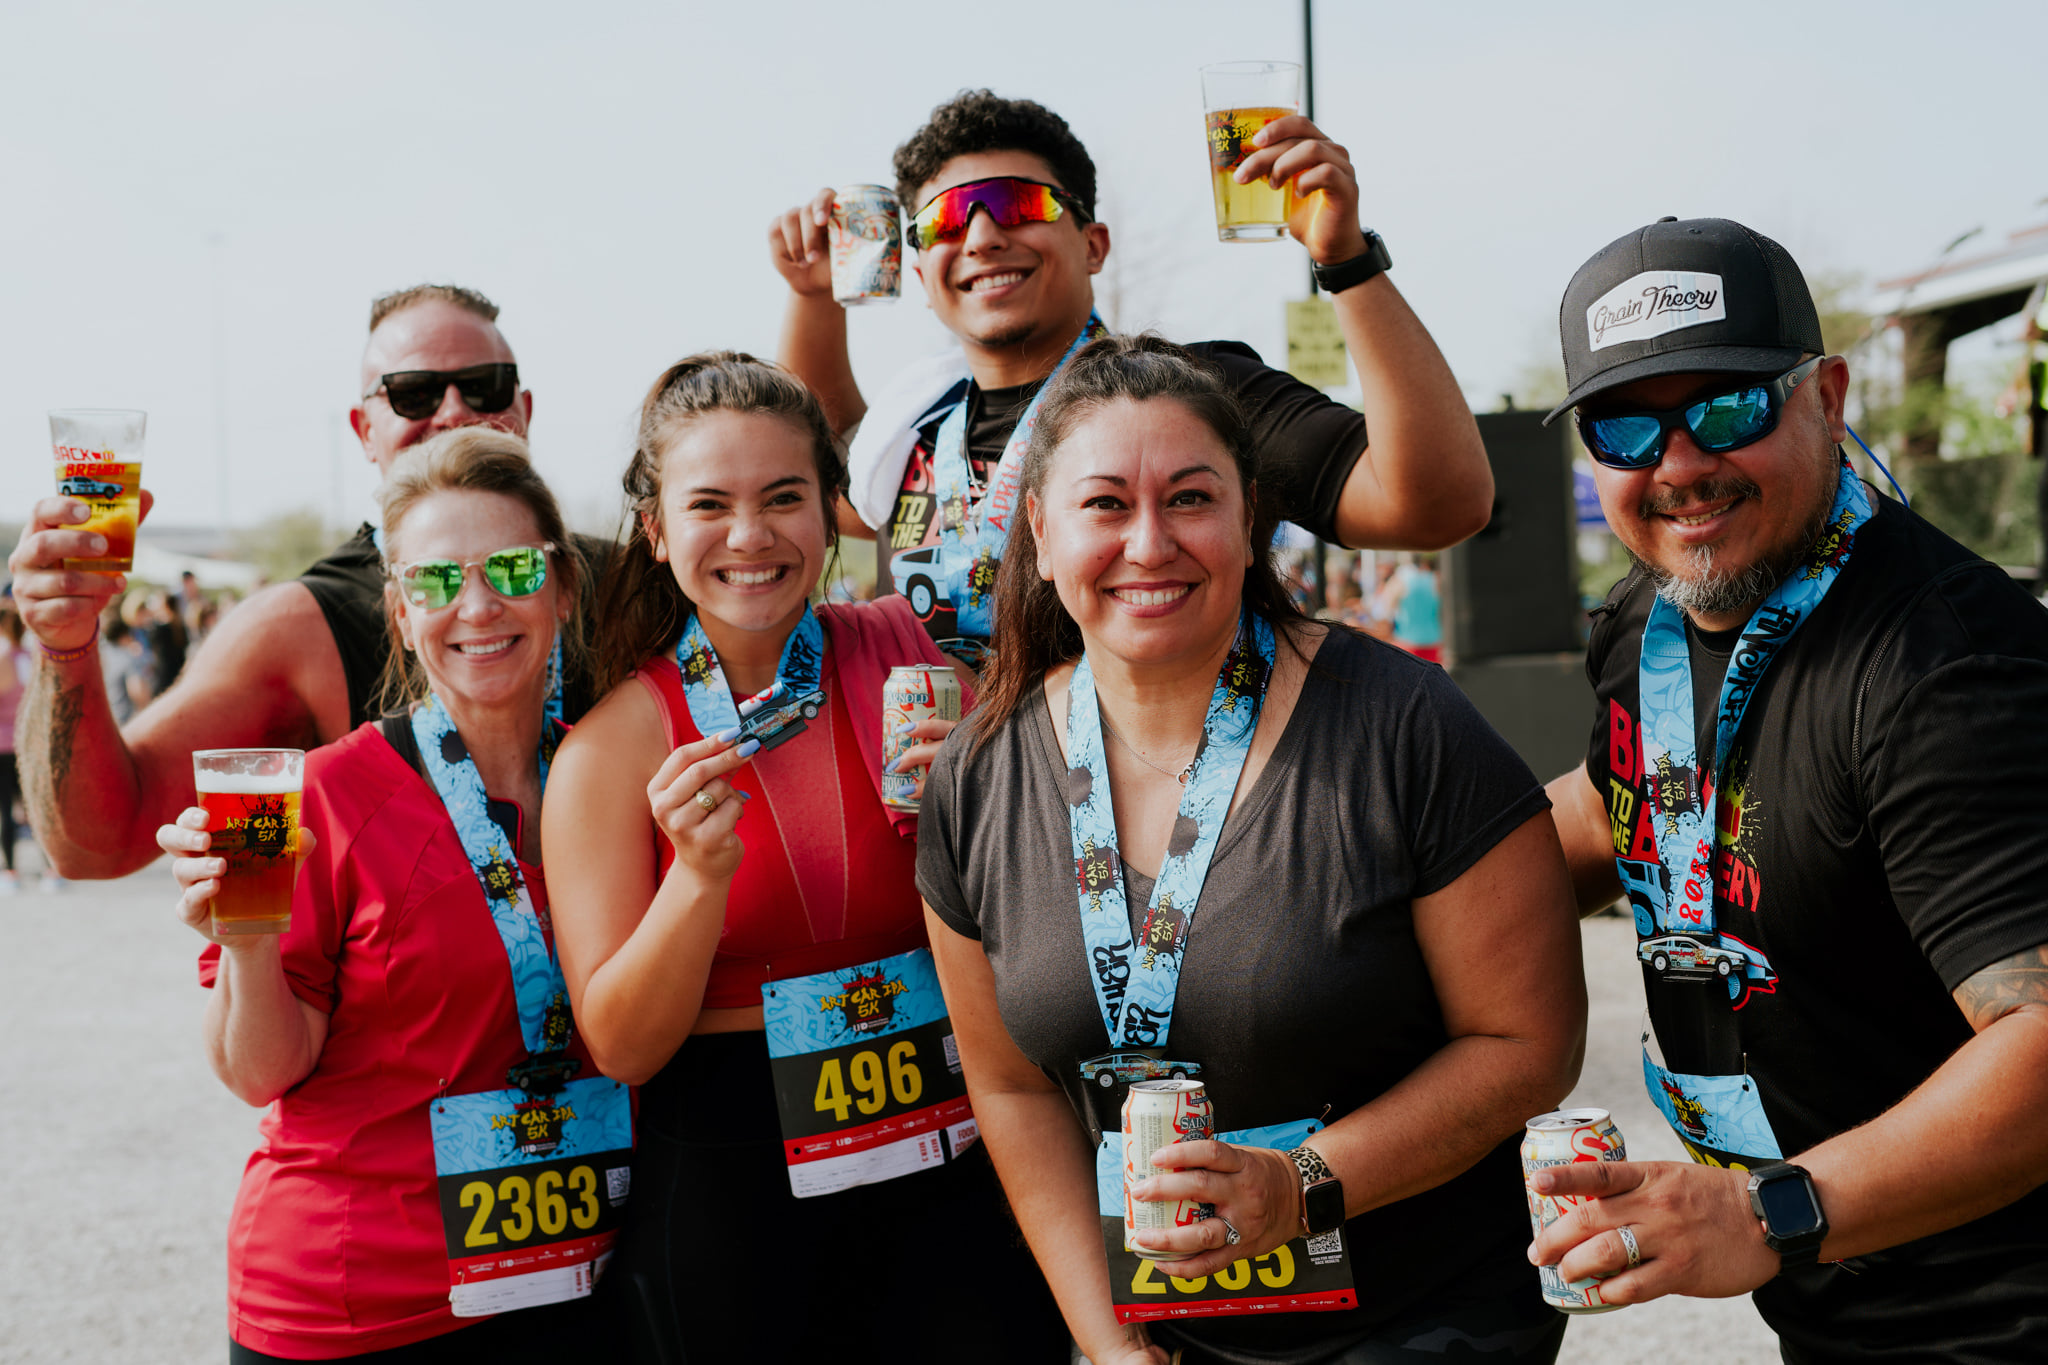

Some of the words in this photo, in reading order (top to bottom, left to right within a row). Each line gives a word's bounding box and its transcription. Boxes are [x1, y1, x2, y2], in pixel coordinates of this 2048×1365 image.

[1594, 299, 1643, 344] Grain
[1642, 285, 1718, 320] Theory
[897, 496, 928, 523] TO
[891, 523, 925, 548] THE
[1222, 686, 1237, 711] ART
[1233, 663, 1245, 685] CAR
[1657, 751, 1670, 777] IPA
[1609, 777, 1634, 824] TO
[1660, 779, 1674, 807] CAR
[1672, 779, 1686, 801] 5K
[226, 816, 253, 830] ART
[253, 815, 280, 830] CAR
[1664, 808, 1678, 834] ART
[257, 828, 277, 842] 5K
[1083, 835, 1094, 859] IPA
[1085, 859, 1098, 886] CAR
[1096, 859, 1109, 880] 5K
[1089, 888, 1102, 912] ART
[1141, 943, 1157, 970] ART
[1150, 917, 1164, 943] CAR
[1157, 891, 1172, 914] IPA
[1161, 921, 1175, 941] 5K
[821, 991, 850, 1013] ART
[848, 983, 882, 1006] CAR
[880, 978, 908, 997] IPA
[855, 999, 880, 1018] 5K
[814, 1040, 923, 1122] 496
[490, 1112, 520, 1131] ART
[518, 1106, 550, 1127] CAR
[550, 1104, 576, 1123] IPA
[1180, 1114, 1209, 1130] SAINT
[525, 1123, 549, 1140] 5K
[459, 1165, 600, 1248] 2363
[1131, 1243, 1295, 1295] 25
